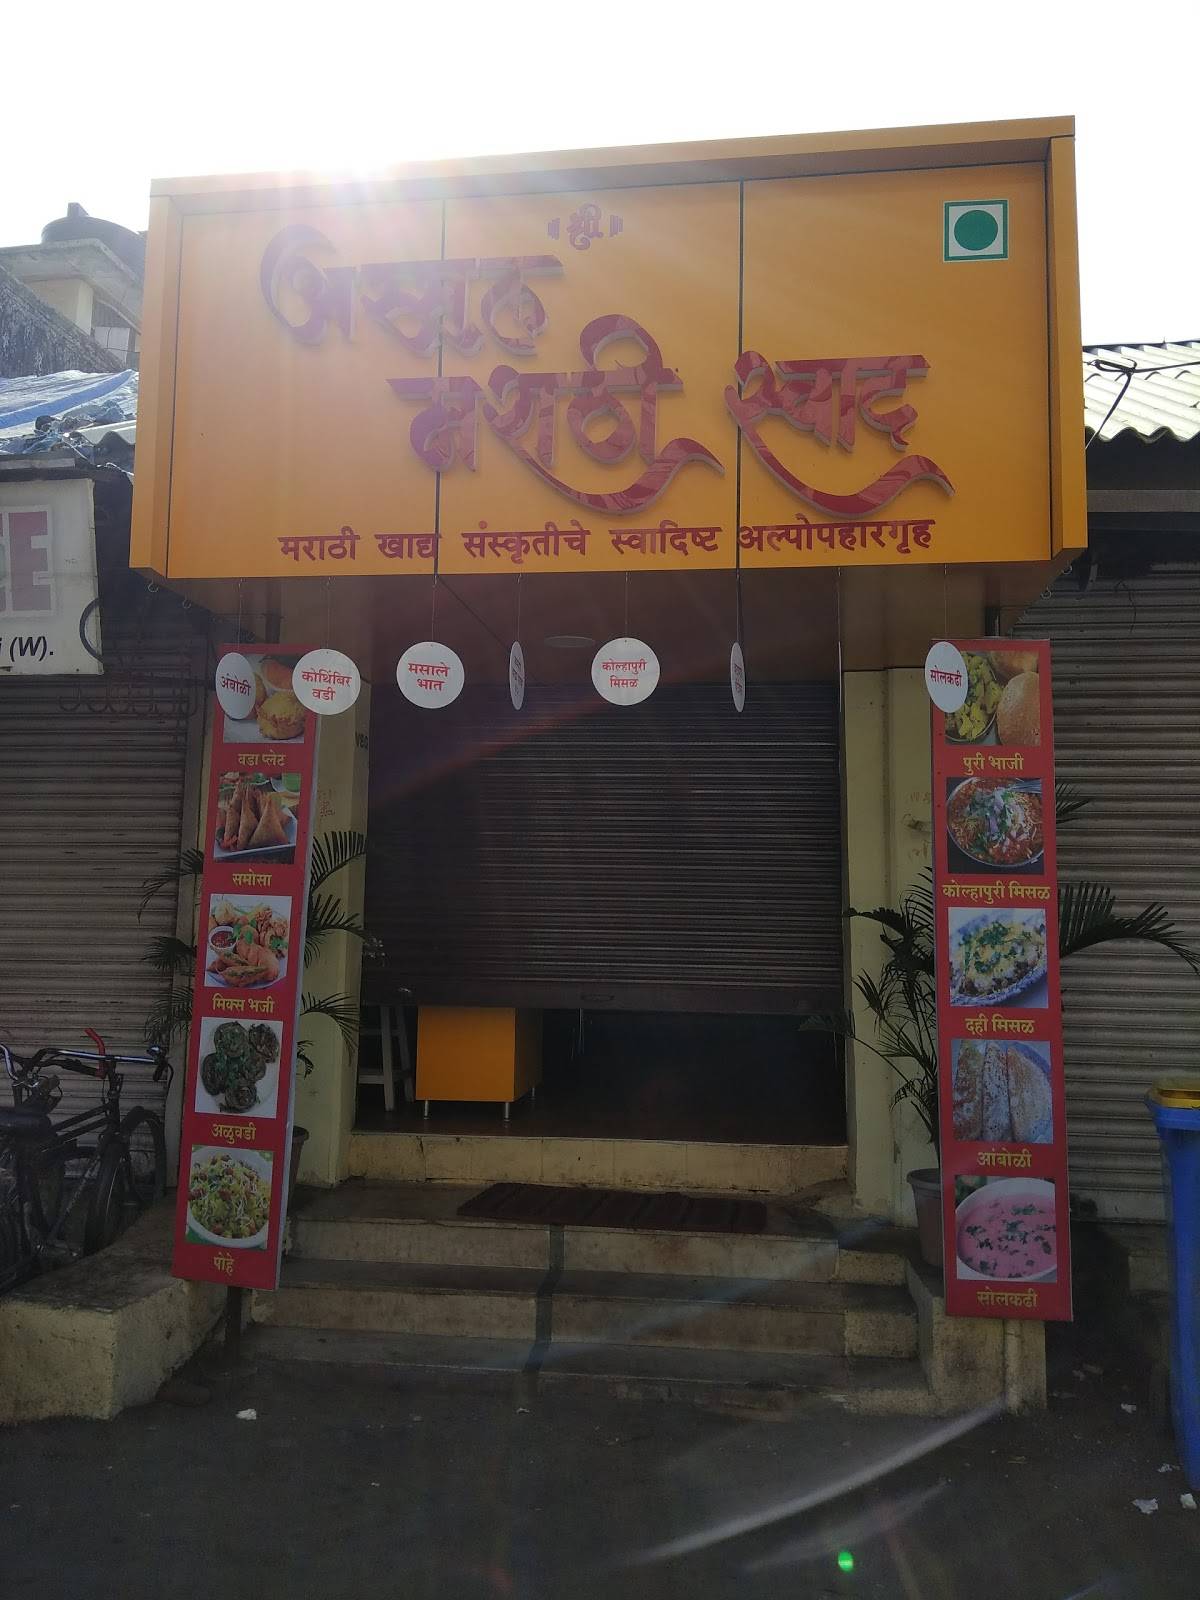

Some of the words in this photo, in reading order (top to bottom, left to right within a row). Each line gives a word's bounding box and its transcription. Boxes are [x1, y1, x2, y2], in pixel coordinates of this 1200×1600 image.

[386, 314, 725, 516] मराठी
[724, 350, 955, 519] स्वाद
[278, 525, 361, 562] मराठी
[374, 533, 442, 560] खाद्य
[460, 519, 591, 565] संस्कृतीचे
[608, 519, 723, 556] स्वादिष्ट
[737, 512, 936, 554] अल्पोपहारगृह
[9, 635, 54, 663] (W).
[408, 661, 451, 677] मसाले
[602, 657, 648, 675] कोल्हापुरी
[417, 678, 445, 691] भात
[609, 674, 639, 688] मिसळ
[312, 686, 336, 701] वडी
[237, 753, 260, 767] वडा
[261, 748, 287, 767] प्लेट
[962, 751, 986, 776] पुरी
[988, 752, 1025, 771] भाजी
[232, 867, 273, 887] समोसा
[942, 879, 1006, 905] कोल्हापुरी
[1008, 880, 1051, 900] मिसळ
[212, 992, 246, 1012] मिक्स
[247, 995, 275, 1013] भजी
[964, 1012, 989, 1037] दही
[991, 1013, 1036, 1034] मिसळ
[211, 1121, 257, 1145] अळुवडी
[213, 1251, 235, 1277] पोहे
